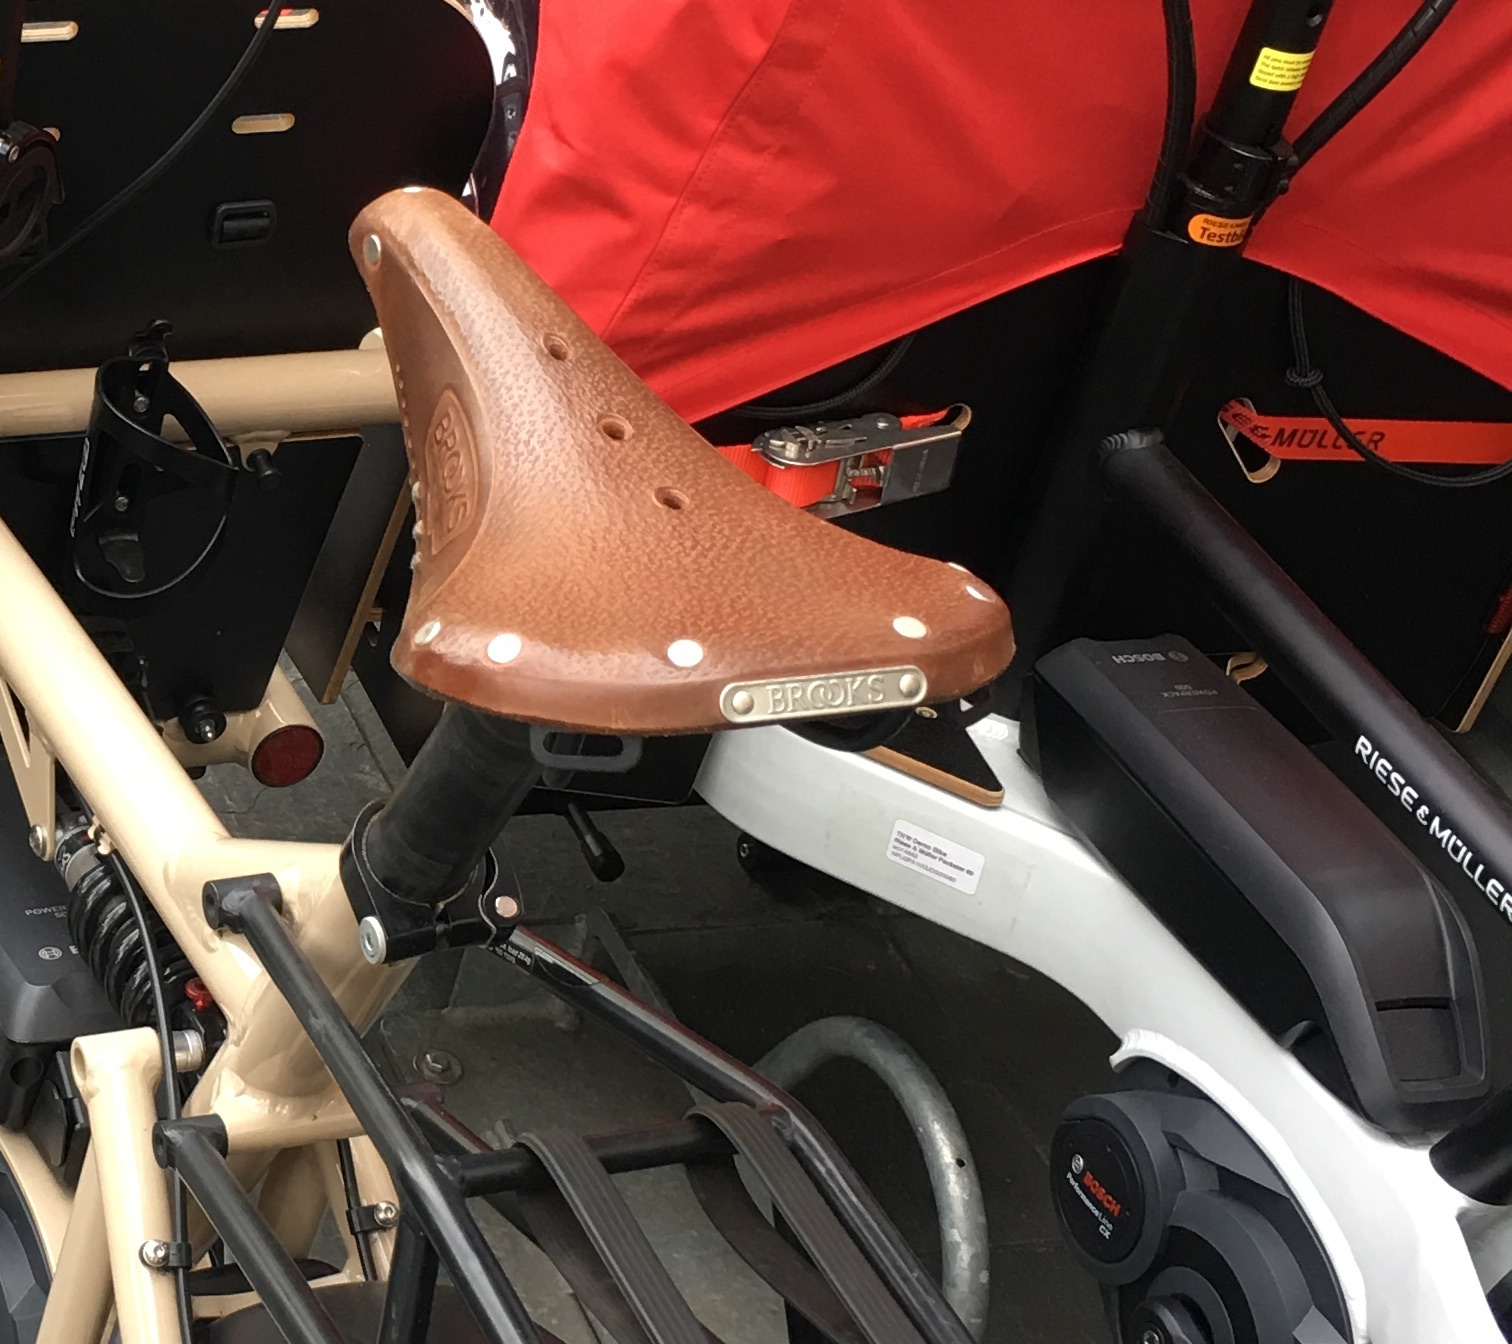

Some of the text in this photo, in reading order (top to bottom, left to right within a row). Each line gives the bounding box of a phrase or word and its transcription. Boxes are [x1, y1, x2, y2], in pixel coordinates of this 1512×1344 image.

[1111, 652, 1167, 664] BOSCH
[765, 674, 886, 715] BROOKS
[1354, 735, 1420, 813] RIESE
[1428, 815, 1512, 923] MÜLLER
[1082, 1170, 1122, 1217] BOSCH
